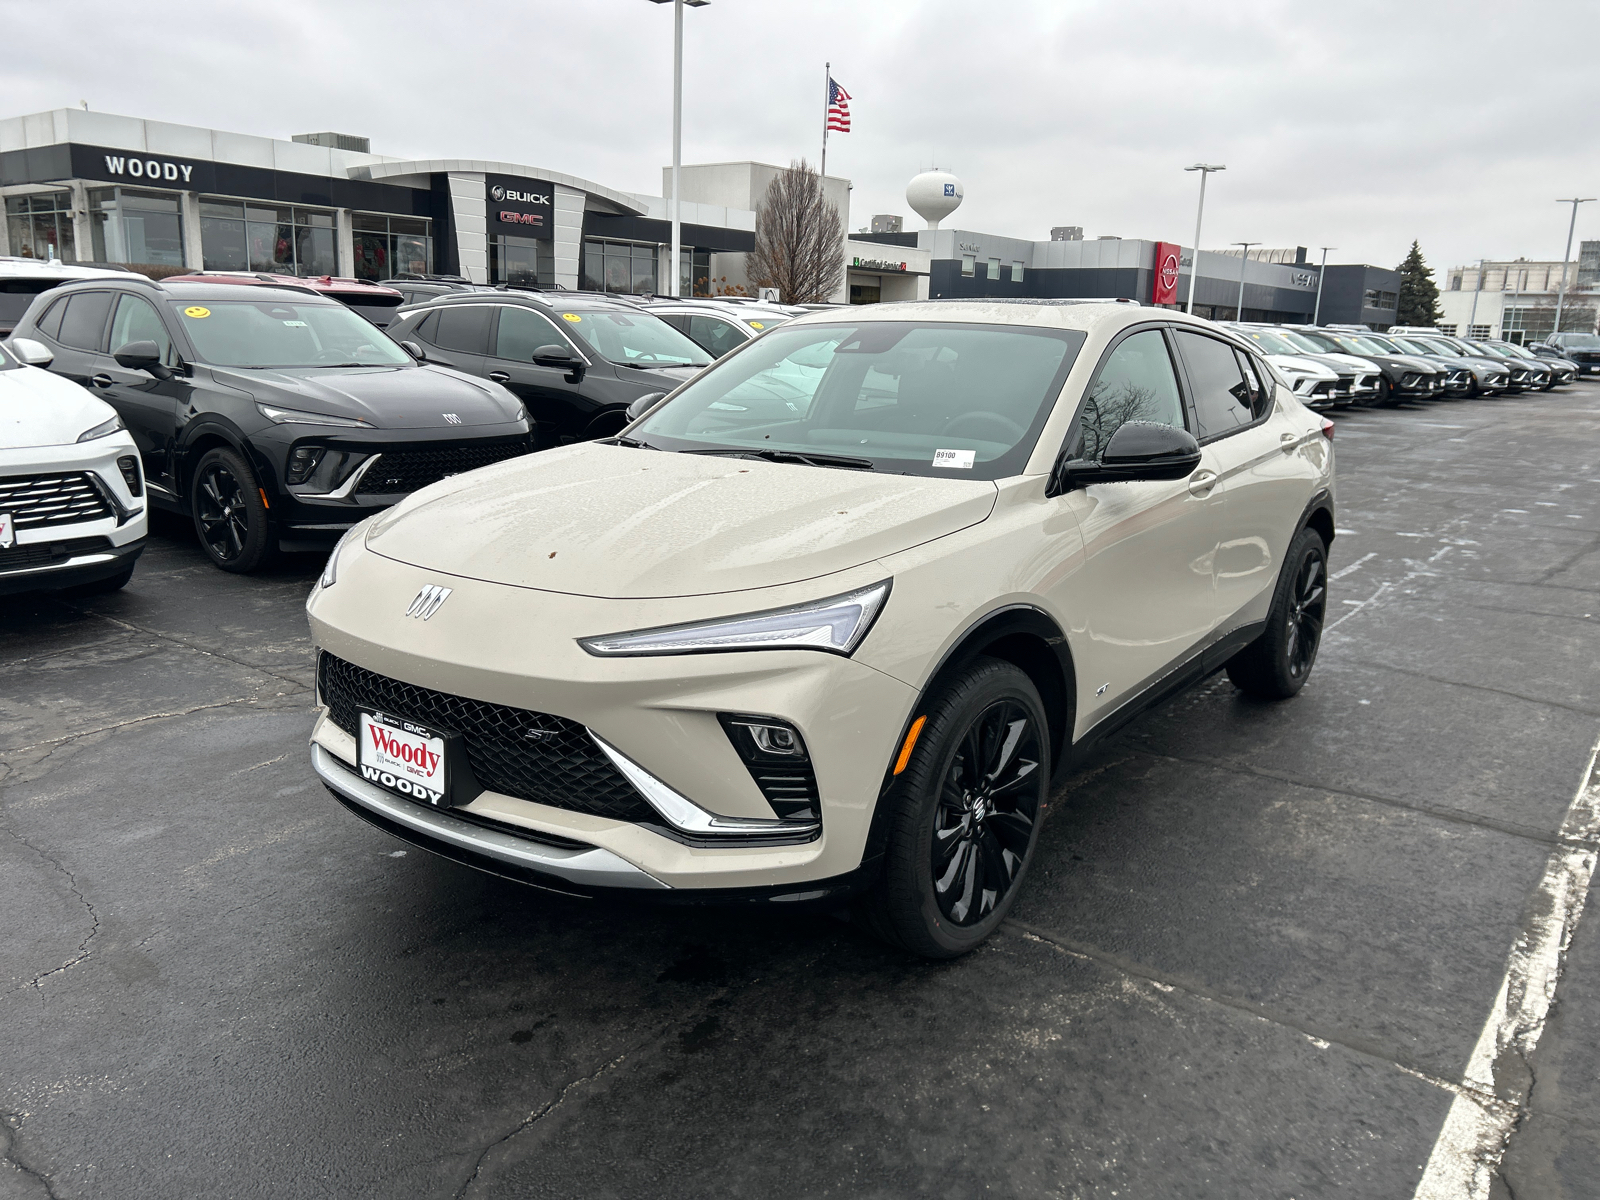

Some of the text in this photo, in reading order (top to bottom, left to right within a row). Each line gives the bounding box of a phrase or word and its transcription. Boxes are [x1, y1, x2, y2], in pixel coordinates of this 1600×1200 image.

[104, 155, 193, 182] WOODY
[506, 189, 551, 206] BUICK
[500, 210, 544, 227] GMC
[860, 258, 883, 269] Certified
[1162, 267, 1179, 276] NISSAN
[383, 716, 427, 736] BUICK GMC
[525, 728, 559, 742] ST
[368, 723, 441, 778] Woody
[384, 757, 425, 778] BUICK GMC
[360, 764, 442, 806] WOODY
